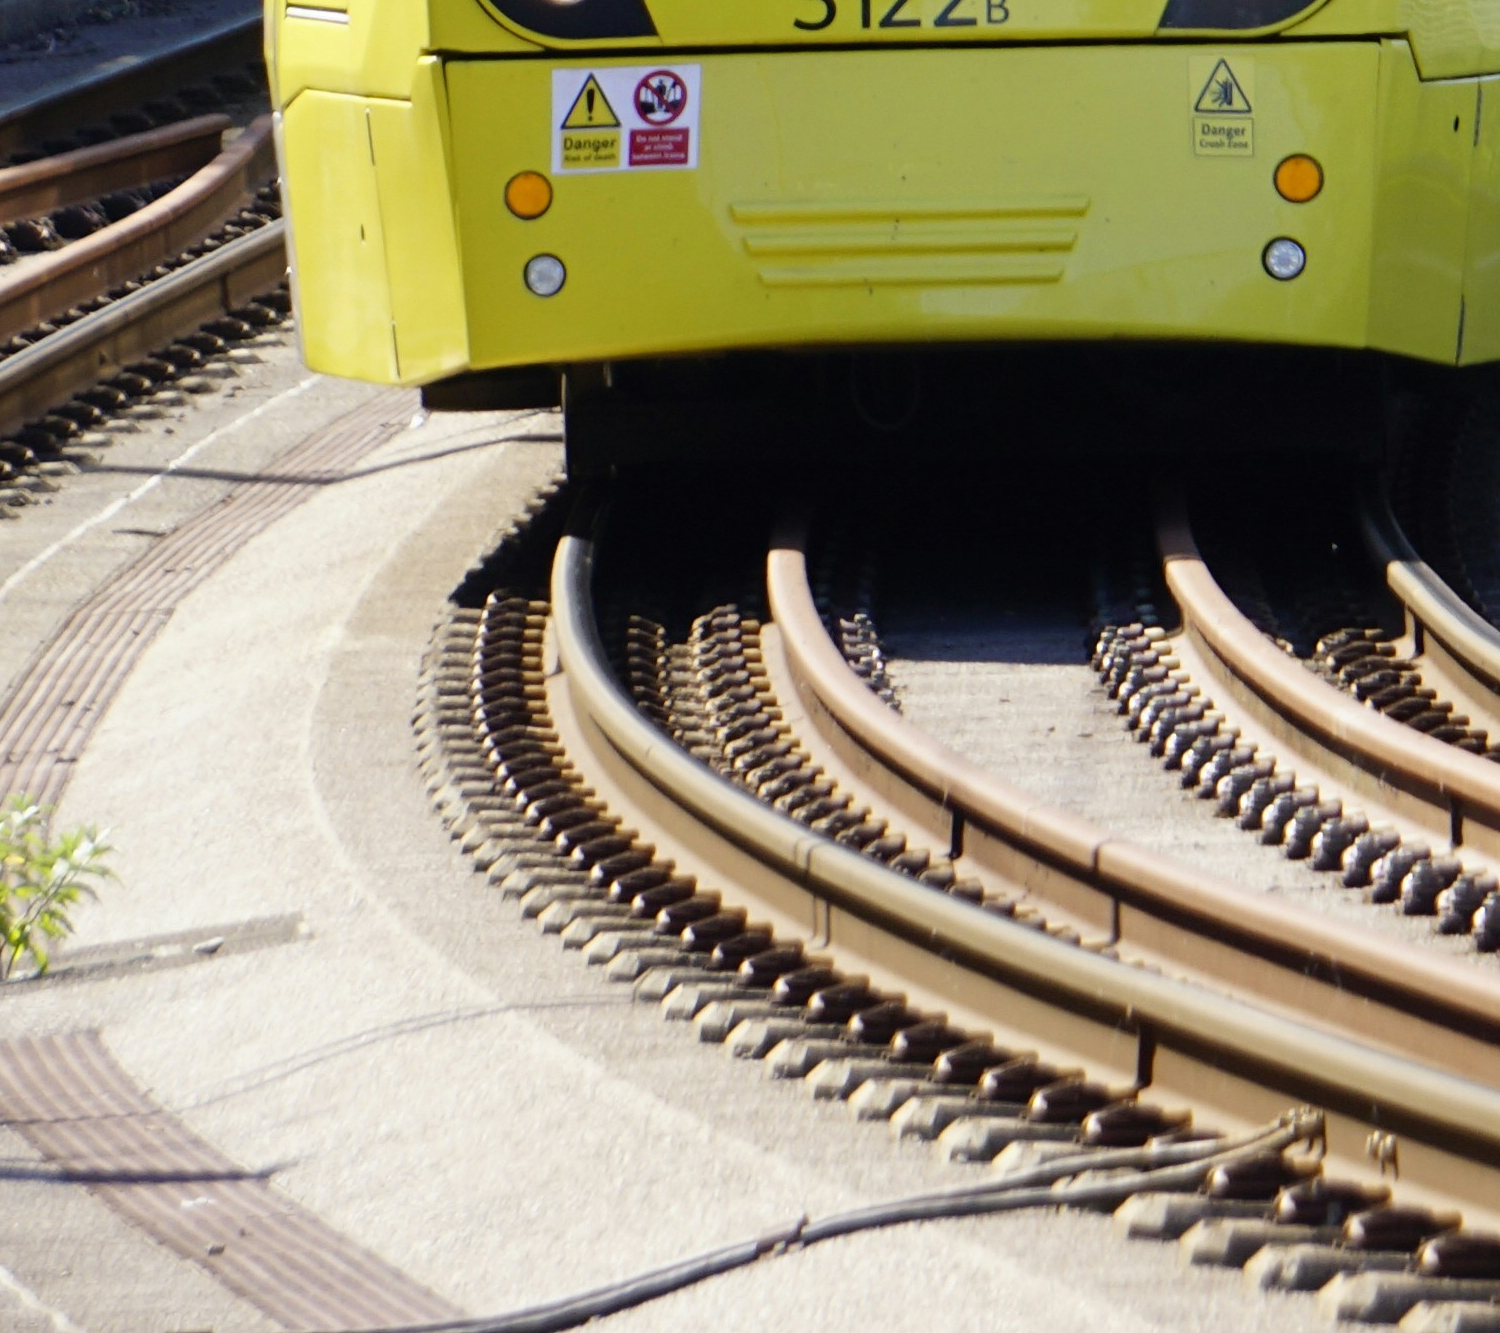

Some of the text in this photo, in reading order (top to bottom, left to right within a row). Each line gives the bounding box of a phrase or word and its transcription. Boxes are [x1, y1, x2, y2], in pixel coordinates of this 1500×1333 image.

[648, 134, 660, 142] not
[1202, 124, 1246, 139] Danger
[564, 137, 617, 152] Danger
